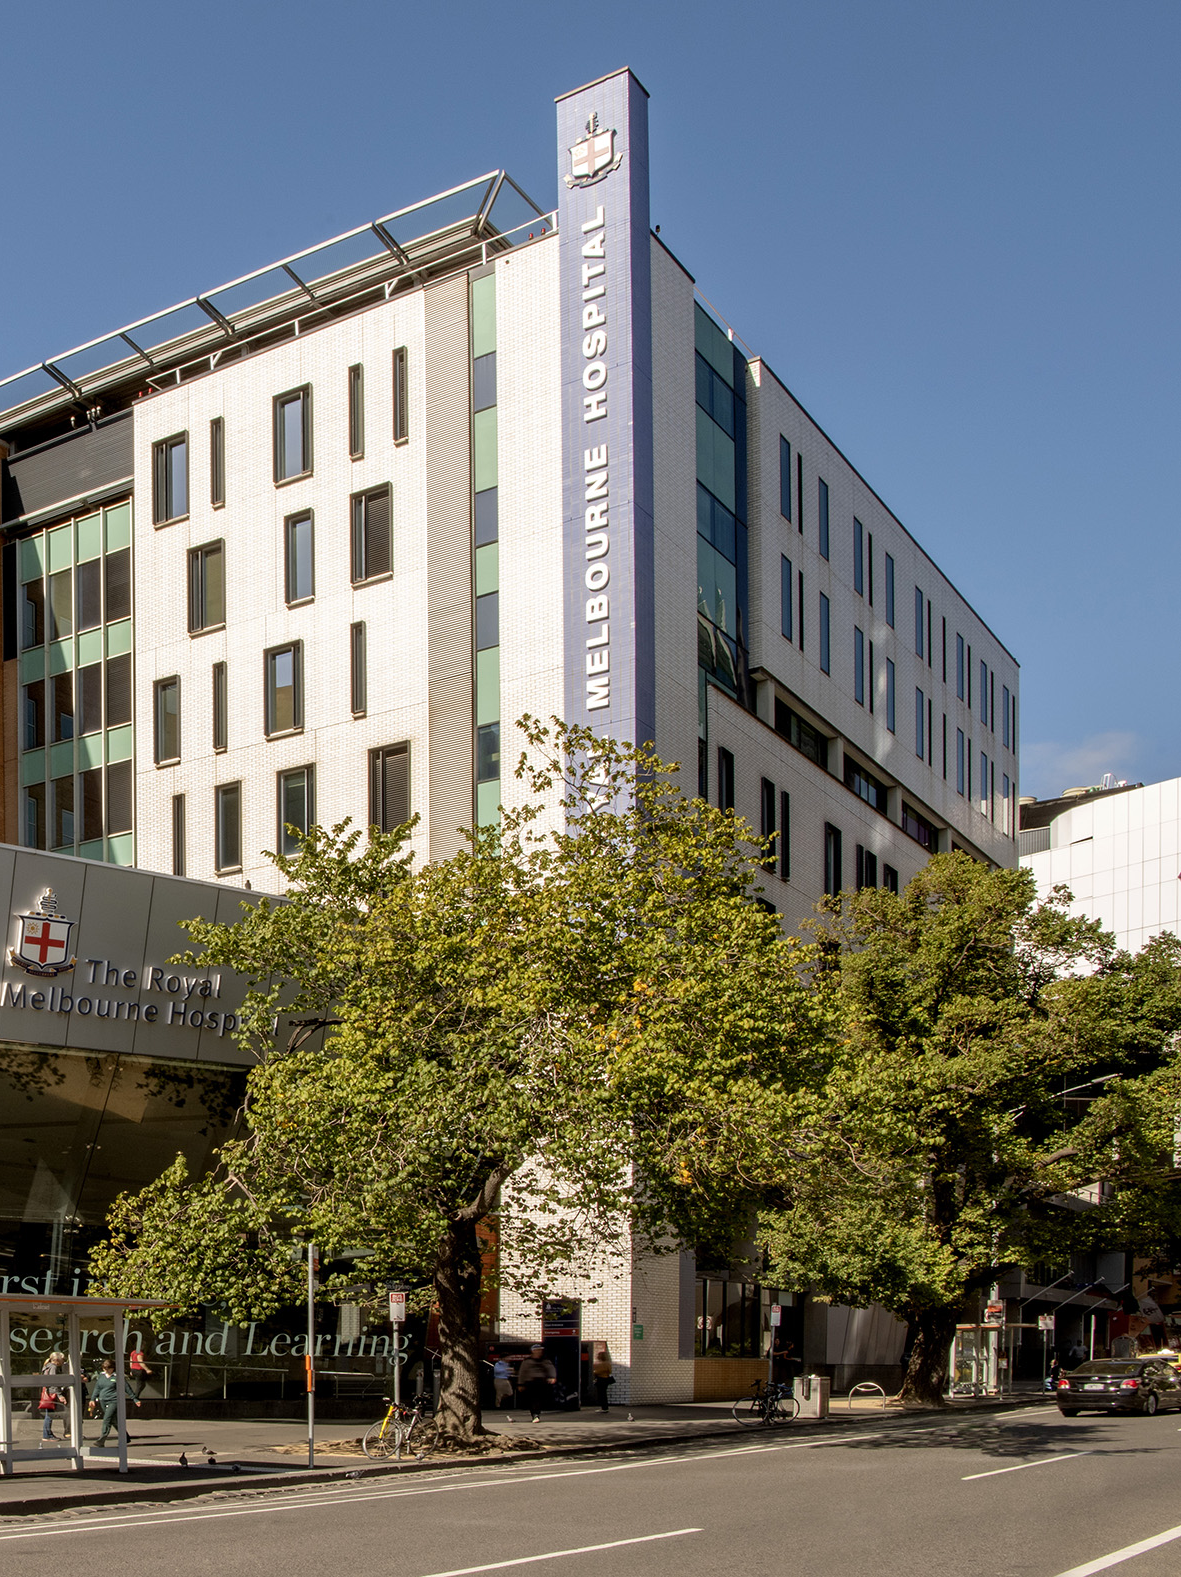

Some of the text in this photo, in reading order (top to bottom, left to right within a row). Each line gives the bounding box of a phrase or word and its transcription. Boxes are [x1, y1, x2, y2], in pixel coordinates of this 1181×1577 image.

[582, 205, 607, 423] HOSPITAL
[584, 443, 610, 712] MELBOURNE
[85, 959, 137, 988] The
[146, 966, 222, 1000] Royal
[0, 981, 279, 1038] Melbourne Hospl
[155, 1321, 229, 1356] and
[245, 1321, 413, 1366] Learning
